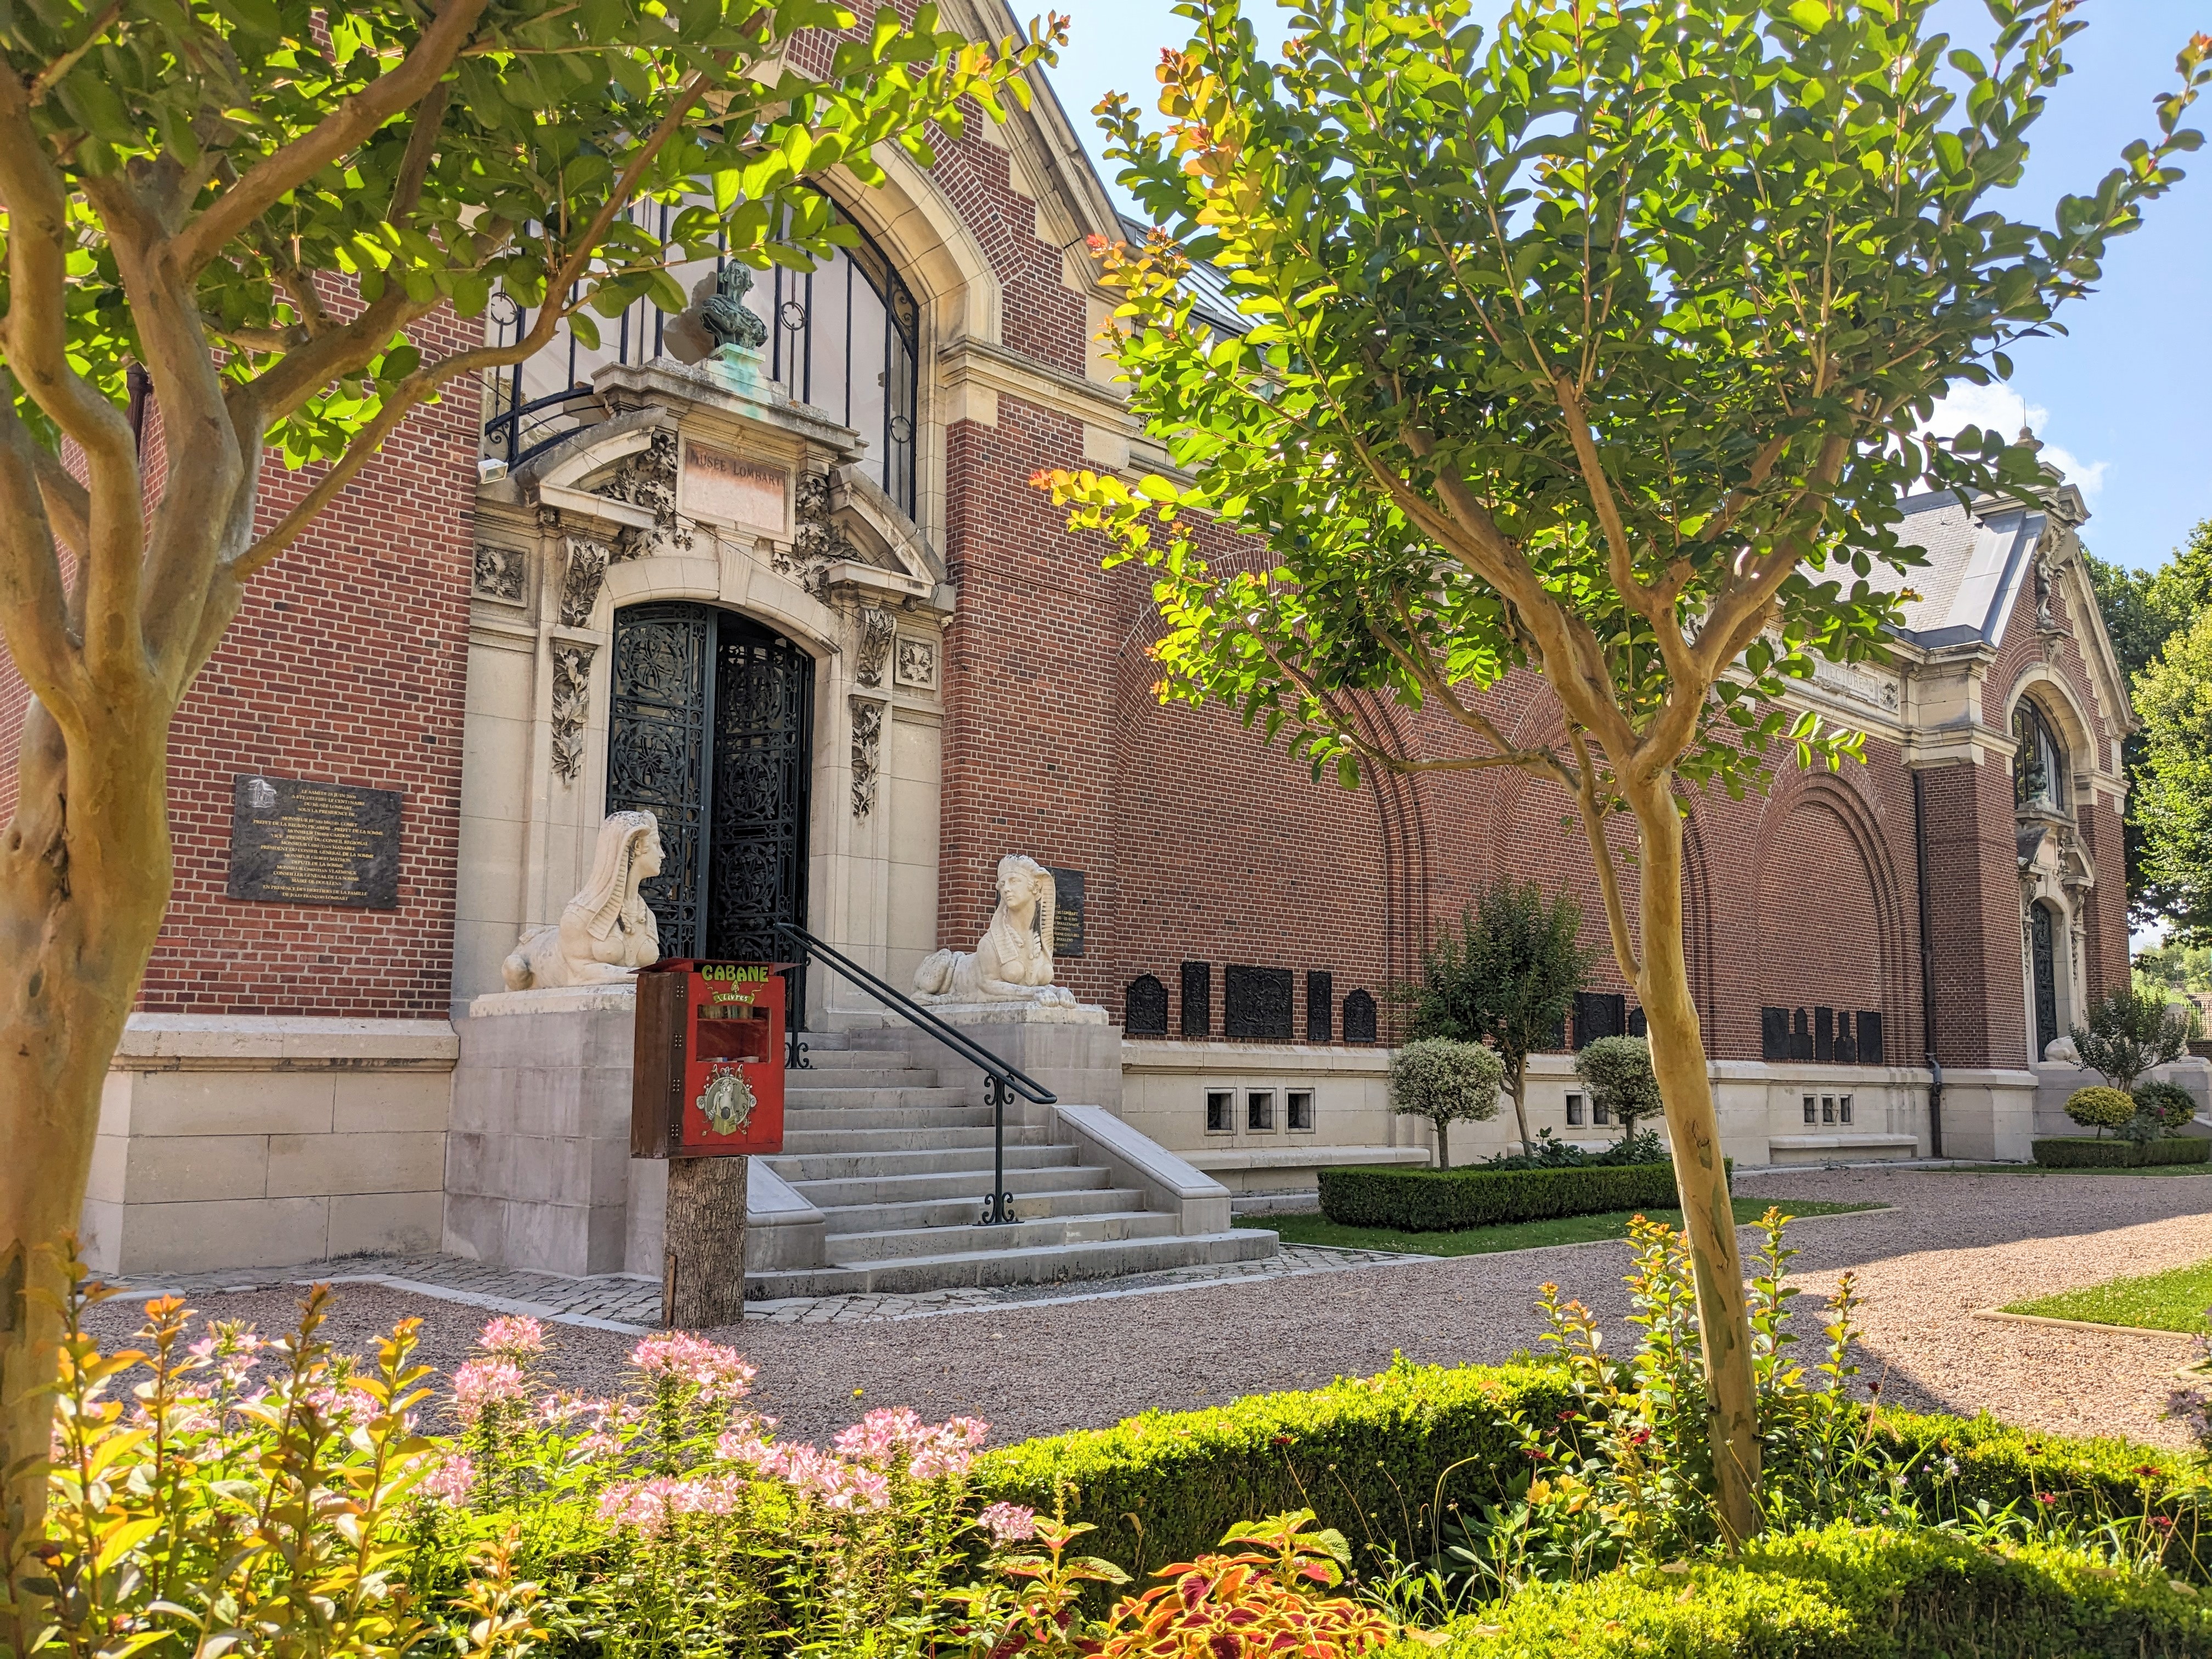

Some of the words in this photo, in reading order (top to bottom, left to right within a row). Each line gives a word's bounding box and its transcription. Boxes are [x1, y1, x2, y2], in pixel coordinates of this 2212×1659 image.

[690, 449, 726, 471] MUSÉE
[733, 461, 782, 487] LOMBART
[1815, 662, 1864, 690] HITECTURE
[702, 964, 769, 983] CABANE
